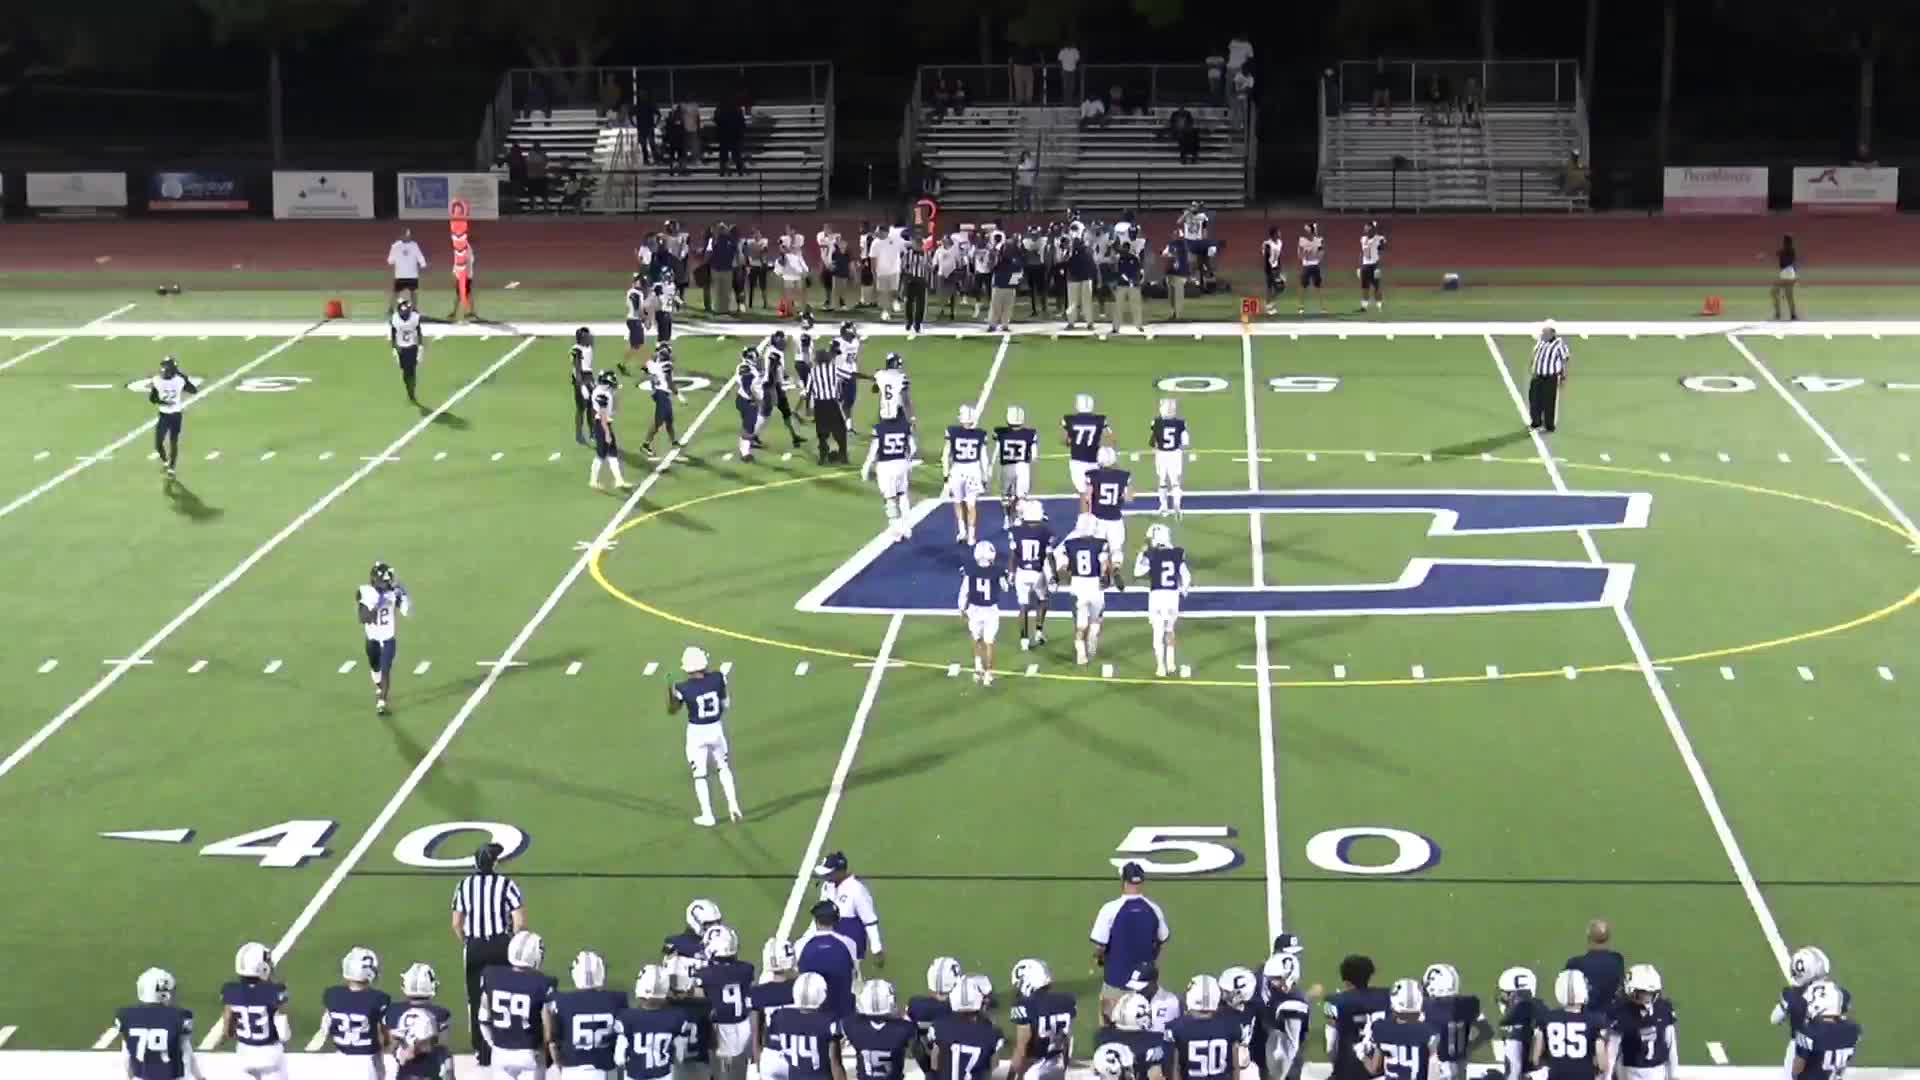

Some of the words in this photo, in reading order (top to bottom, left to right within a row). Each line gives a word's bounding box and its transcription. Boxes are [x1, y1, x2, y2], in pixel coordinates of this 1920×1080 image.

[883, 433, 905, 454] 55
[955, 438, 979, 459] 56
[1072, 425, 1096, 446] 77
[1163, 427, 1176, 448] 5
[1002, 439, 1026, 460] 53
[1098, 483, 1119, 505] 51
[1076, 550, 1091, 575] 8
[1161, 561, 1175, 586] 2
[976, 577, 990, 601] 4
[695, 691, 720, 718] 13
[232, 1006, 269, 1040] 33
[492, 990, 531, 1029] 59
[331, 1012, 372, 1046] 32
[573, 1014, 614, 1050] 62
[1547, 1022, 1588, 1058] 85
[129, 1028, 170, 1063] 79
[633, 1032, 673, 1069] 40
[1188, 1039, 1228, 1077] 50
[861, 1049, 892, 1077] 15
[951, 1043, 981, 1080] 17
